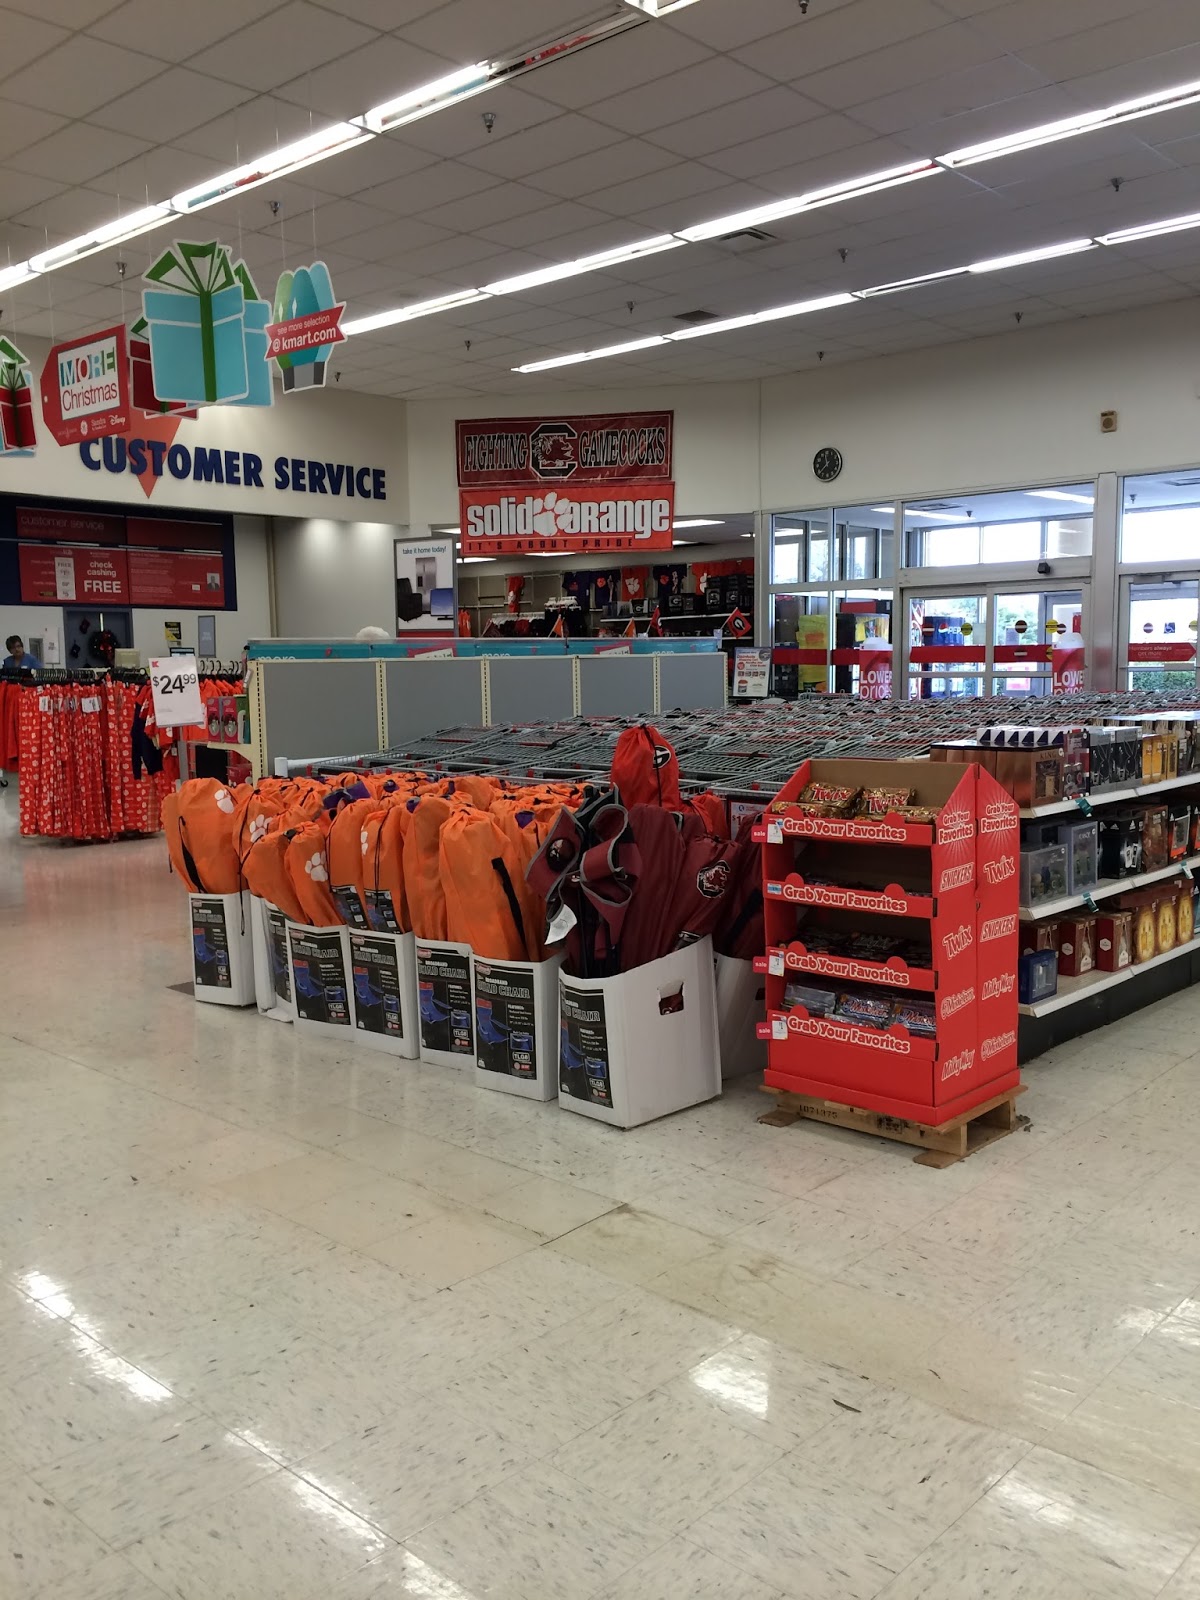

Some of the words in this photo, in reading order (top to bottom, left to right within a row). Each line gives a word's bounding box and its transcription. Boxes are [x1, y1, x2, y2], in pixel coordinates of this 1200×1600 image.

[277, 326, 288, 335] see
[288, 322, 303, 332] more
[303, 315, 330, 328] selection
[282, 327, 336, 350] kmart.com
[60, 346, 116, 387] MORE
[62, 382, 118, 411] Christmas
[464, 433, 528, 472] FIGHTING
[579, 427, 667, 468] GAMECOCKS
[79, 436, 264, 487] CUSTOMER
[274, 456, 387, 500] SERVICE
[467, 496, 534, 537] solid
[468, 541, 503, 551] IT'S
[516, 539, 569, 549] ABOUT
[582, 538, 634, 548] PRIDE
[86, 569, 117, 578] cashing
[89, 561, 113, 569] check
[83, 580, 122, 593] FREE
[1053, 670, 1084, 687] LOWE
[943, 814, 958, 826] Grab
[958, 811, 970, 822] Your
[986, 804, 1000, 816] Grab
[1000, 803, 1014, 813] Your
[783, 818, 814, 836] Grab
[814, 820, 846, 838] Your
[846, 823, 907, 841] Favorites
[939, 824, 973, 845] Favorites
[981, 816, 1017, 833] Favorites
[939, 862, 974, 892] SNICKERS
[983, 855, 1016, 884] Twix
[783, 884, 815, 901] Grab
[814, 888, 846, 906] Your
[847, 892, 908, 914] Favorites
[980, 914, 1017, 942] SNICKERS
[942, 925, 973, 960] Twix
[439, 967, 468, 980] CHAIR
[786, 952, 818, 970] Grab
[818, 958, 849, 976] Your
[850, 963, 910, 985] Favorites
[498, 985, 531, 999] CHAIR
[571, 1006, 600, 1021] CHAIR
[787, 1015, 819, 1033] Grab
[819, 1022, 850, 1041] Your
[851, 1028, 911, 1053] Favorites
